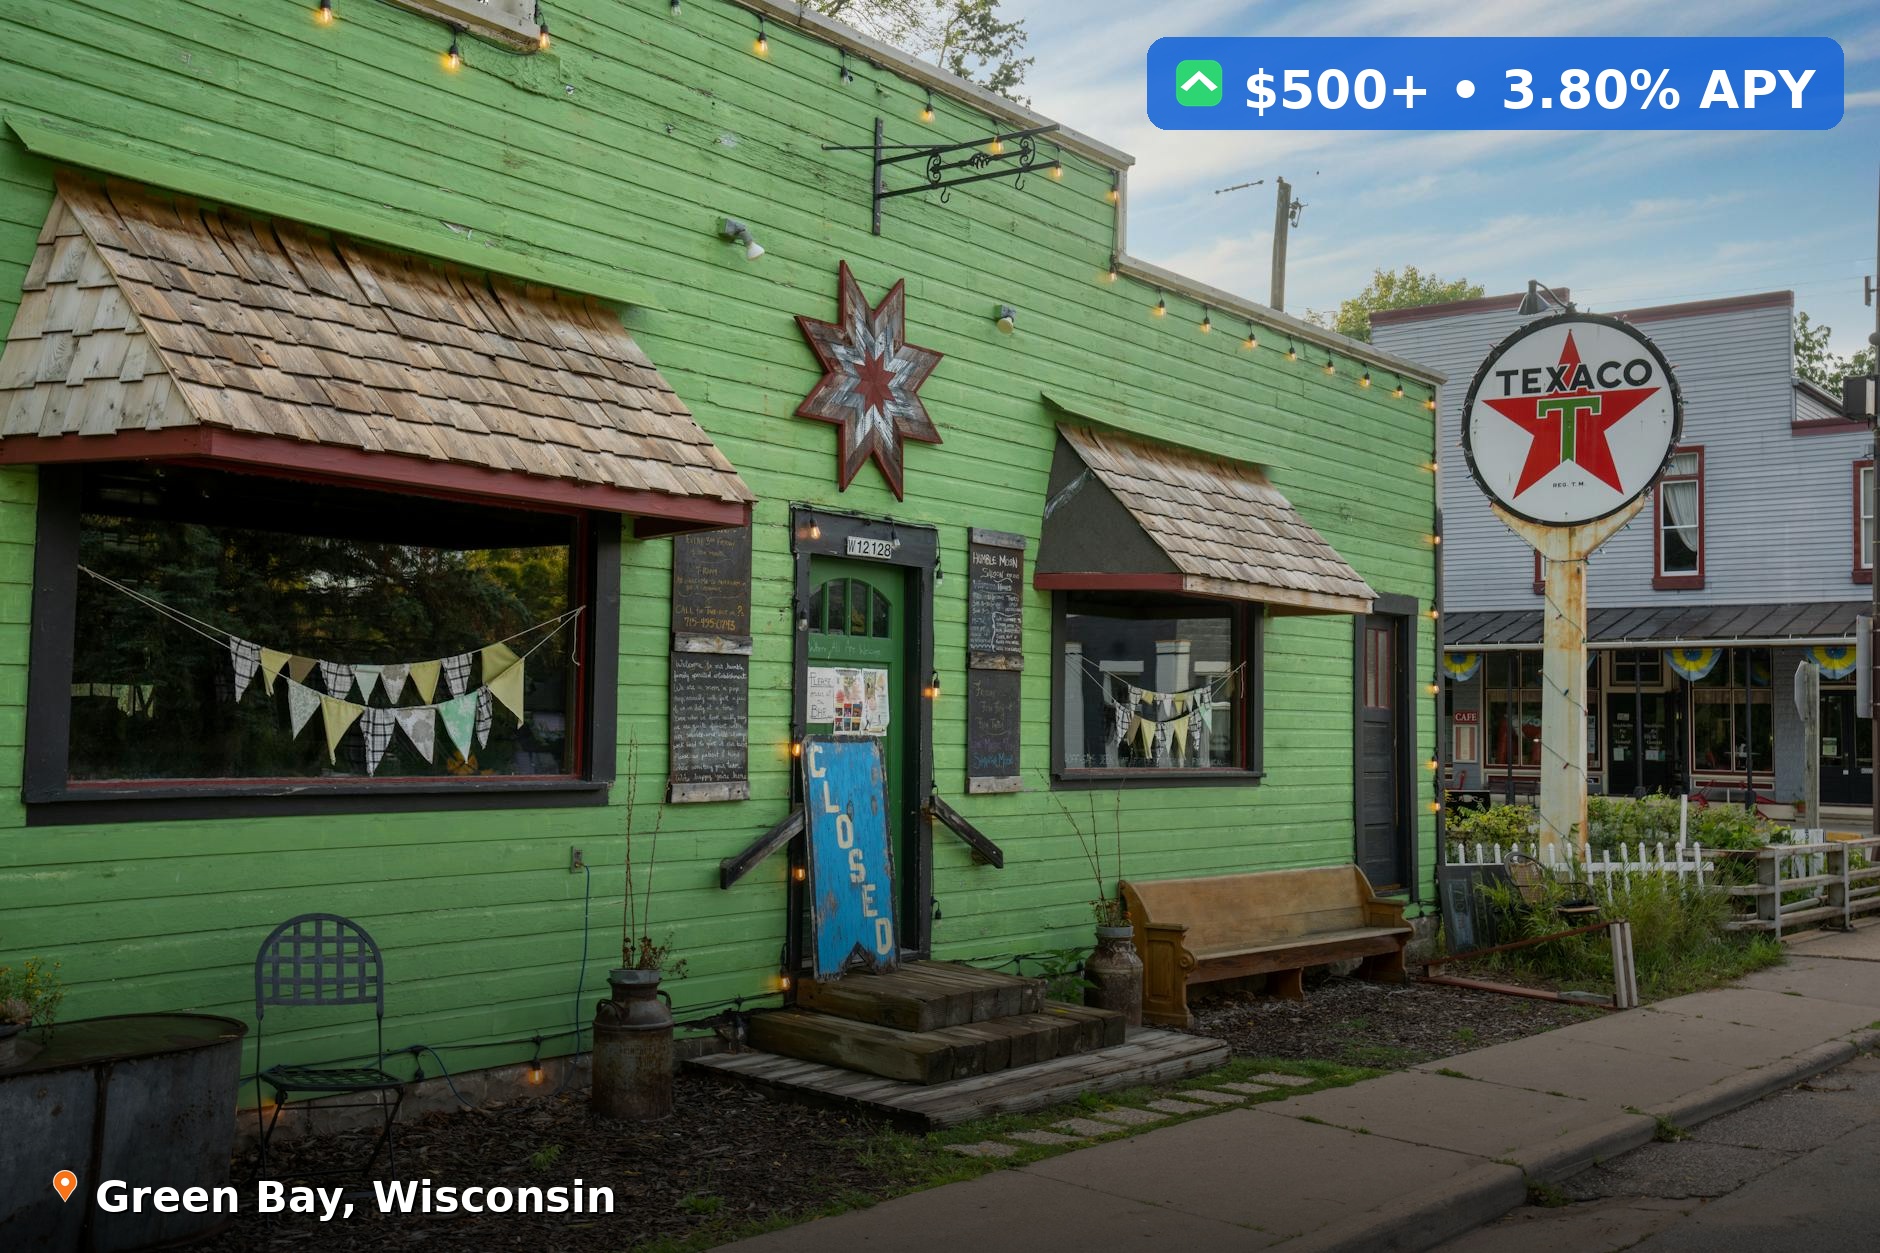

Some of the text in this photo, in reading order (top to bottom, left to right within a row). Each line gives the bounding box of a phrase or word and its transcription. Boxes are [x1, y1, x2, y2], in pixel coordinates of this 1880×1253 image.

[1496, 359, 1652, 396] TEXACO
[1537, 396, 1602, 464] T
[973, 551, 1018, 569] HUMBLE MOON
[1455, 712, 1477, 721] CAFE
[809, 744, 892, 956] CLOSED
